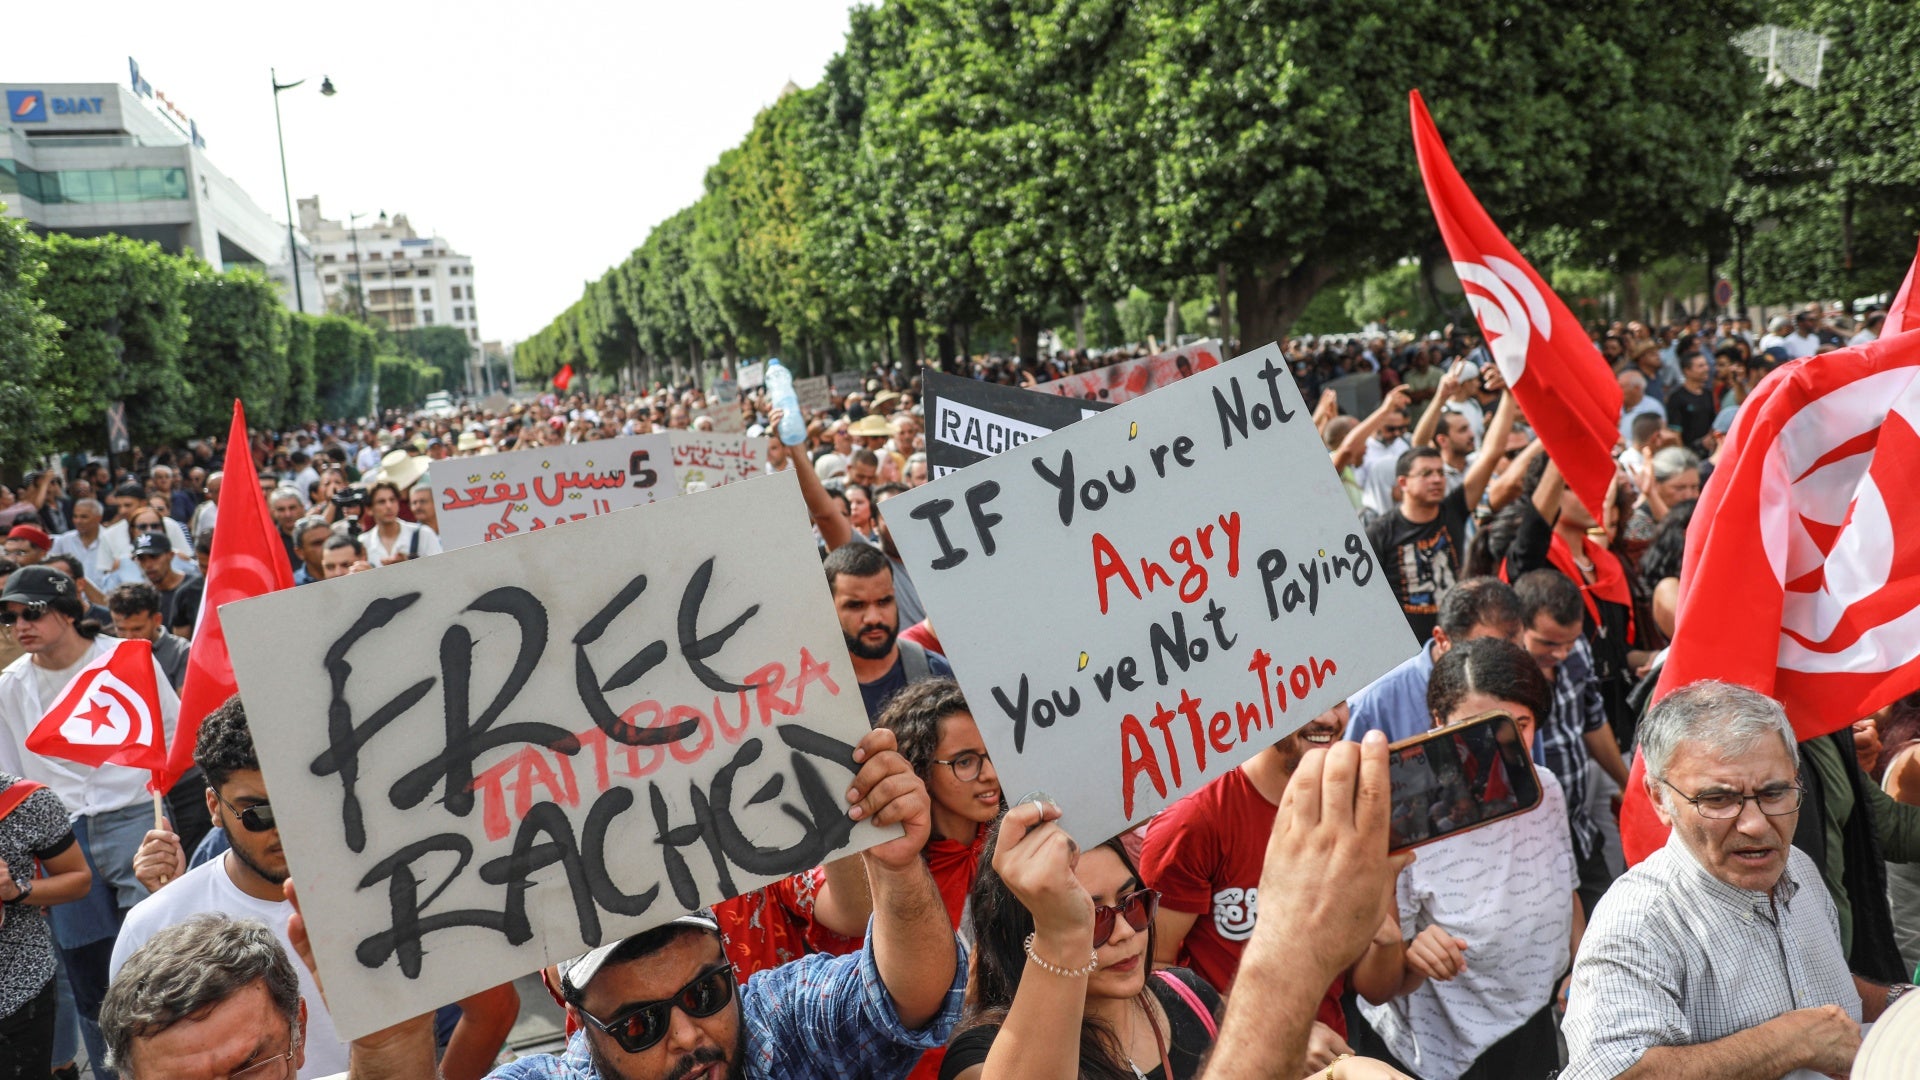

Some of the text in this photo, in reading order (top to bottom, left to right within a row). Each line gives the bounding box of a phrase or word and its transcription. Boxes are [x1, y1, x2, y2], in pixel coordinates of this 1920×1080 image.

[51, 97, 104, 115] BIAT
[629, 450, 657, 488] 5
[910, 358, 1296, 571] IF You're Not
[1092, 511, 1242, 616] Angry
[1150, 598, 1238, 686] Not
[1257, 533, 1374, 622] Paying
[309, 557, 774, 854] FREE
[1120, 648, 1338, 821] Attention
[354, 723, 860, 981] RACHED
